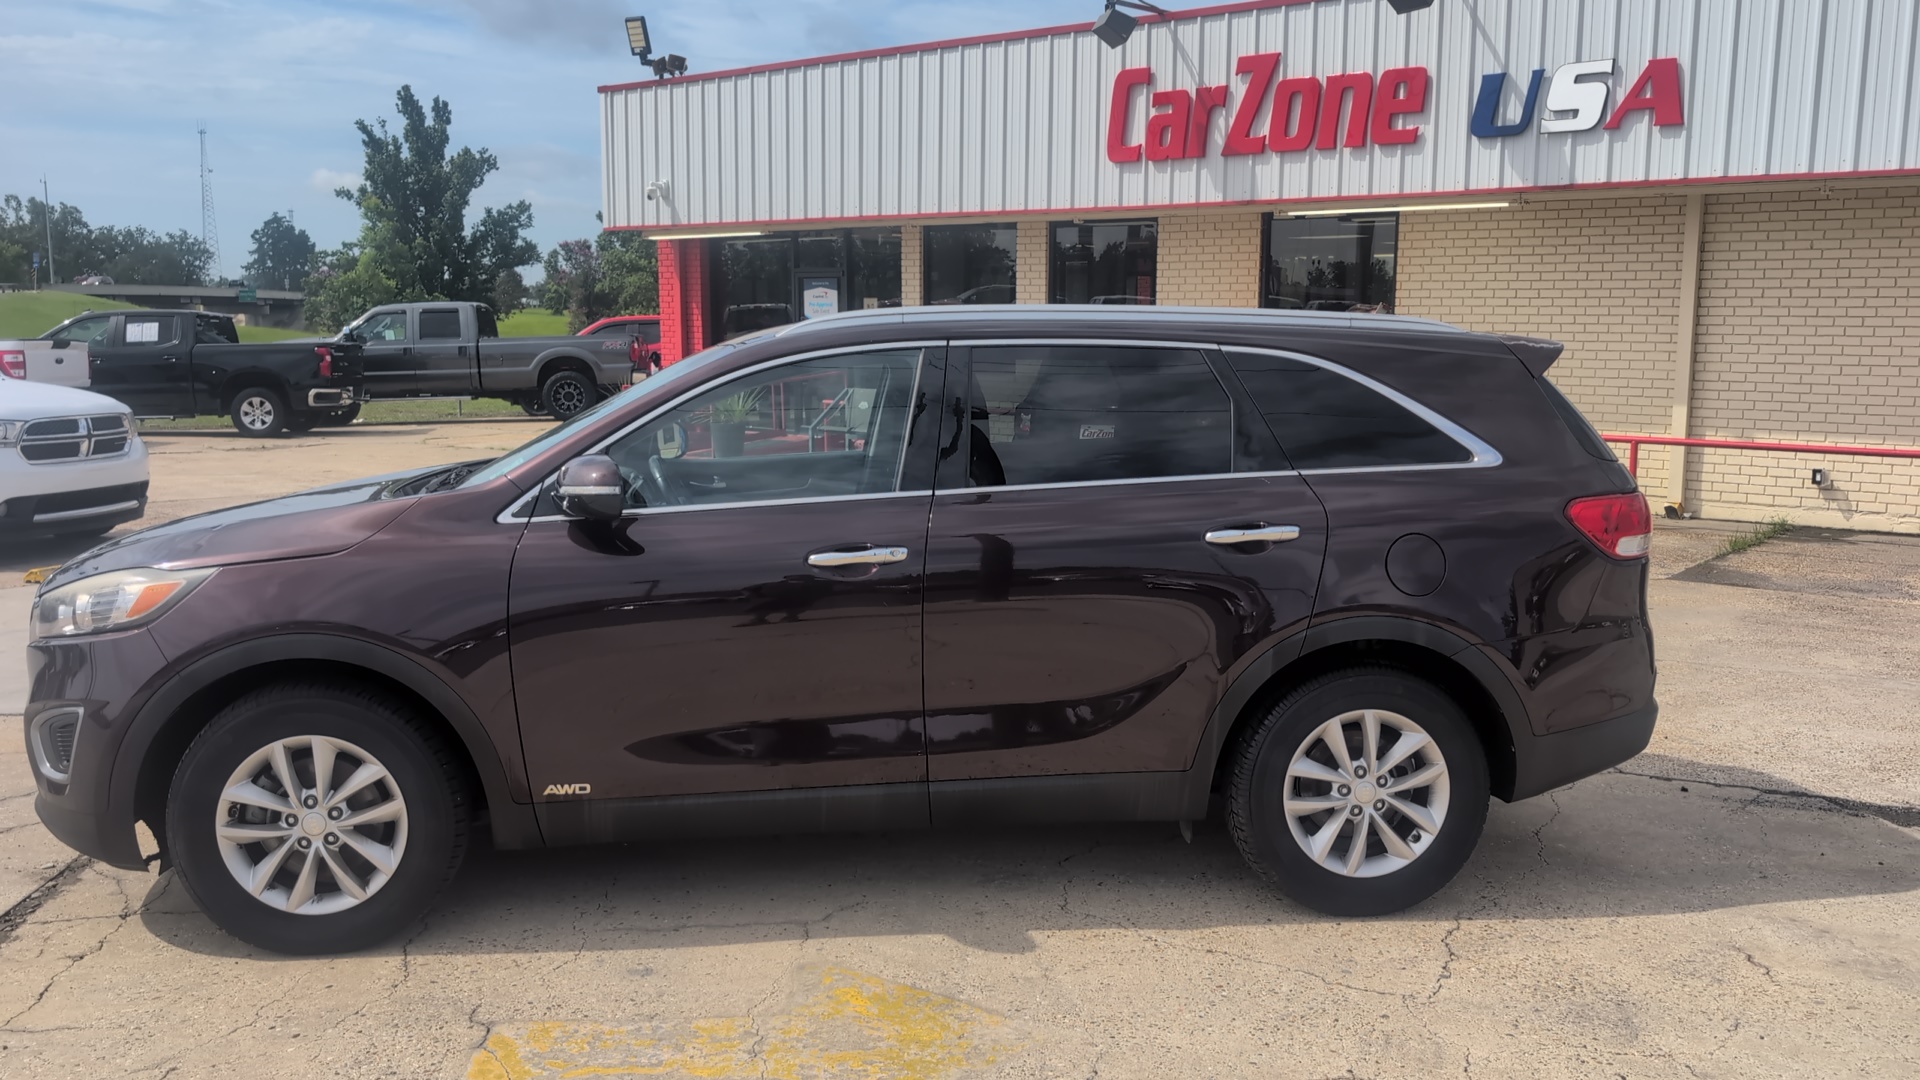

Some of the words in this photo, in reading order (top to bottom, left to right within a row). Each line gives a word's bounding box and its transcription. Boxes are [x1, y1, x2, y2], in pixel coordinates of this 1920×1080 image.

[1107, 52, 1430, 163] CarZone
[1471, 58, 1684, 138] USA
[1081, 429, 1114, 438] CarZon
[543, 783, 591, 796] AWD
